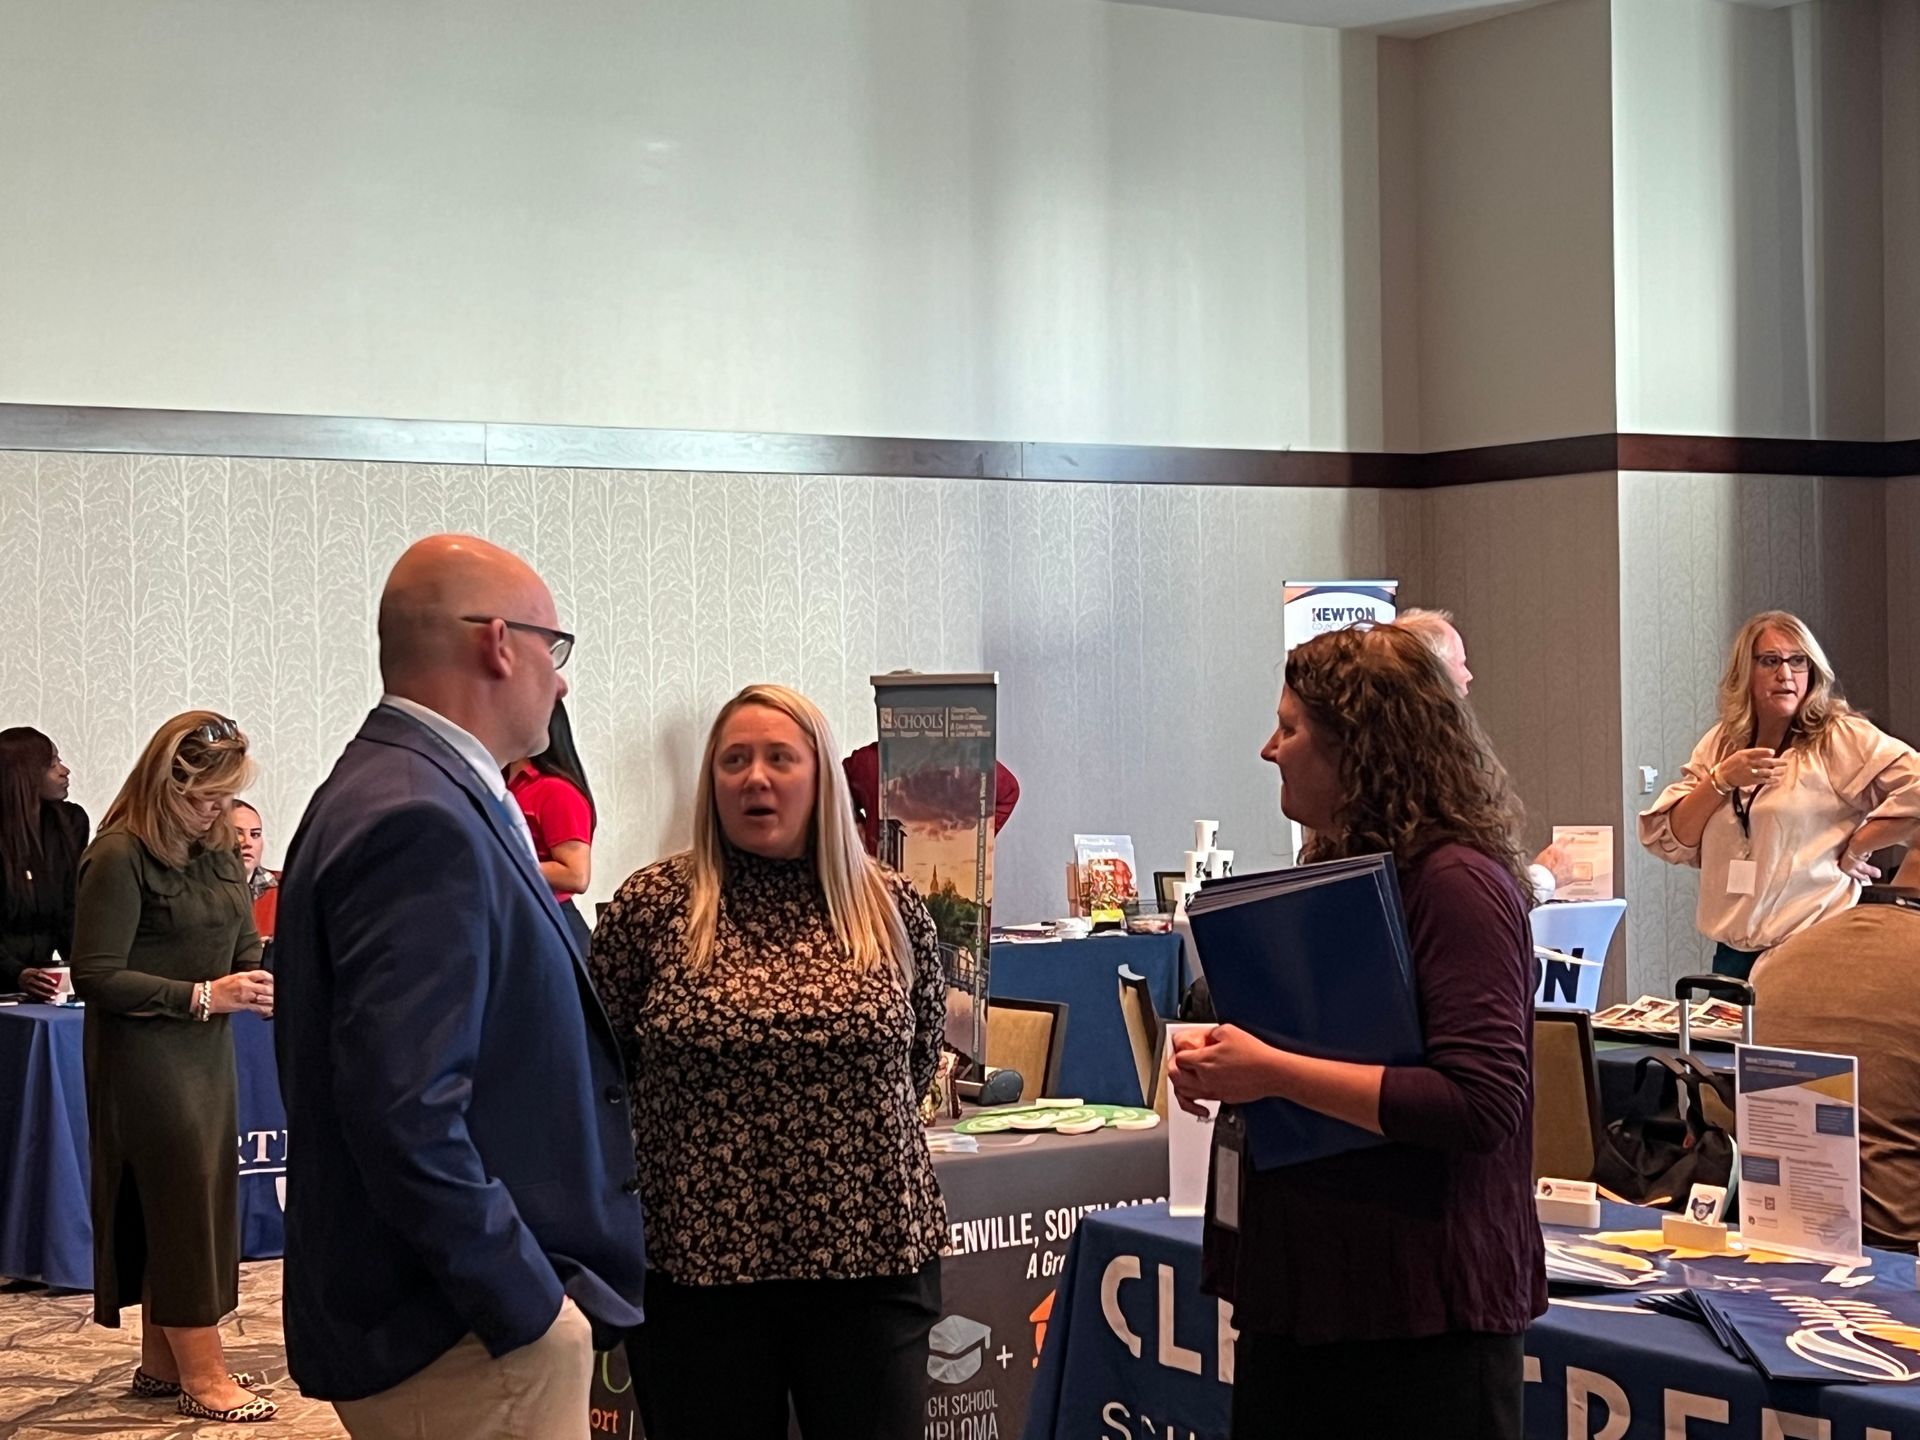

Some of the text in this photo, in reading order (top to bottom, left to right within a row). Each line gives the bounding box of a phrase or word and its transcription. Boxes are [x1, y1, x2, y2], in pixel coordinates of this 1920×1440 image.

[1312, 607, 1376, 621] NEWTON
[893, 714, 944, 729] SCHOOLS
[1026, 1252, 1038, 1279] A
[951, 1388, 999, 1416] SCHOOL
